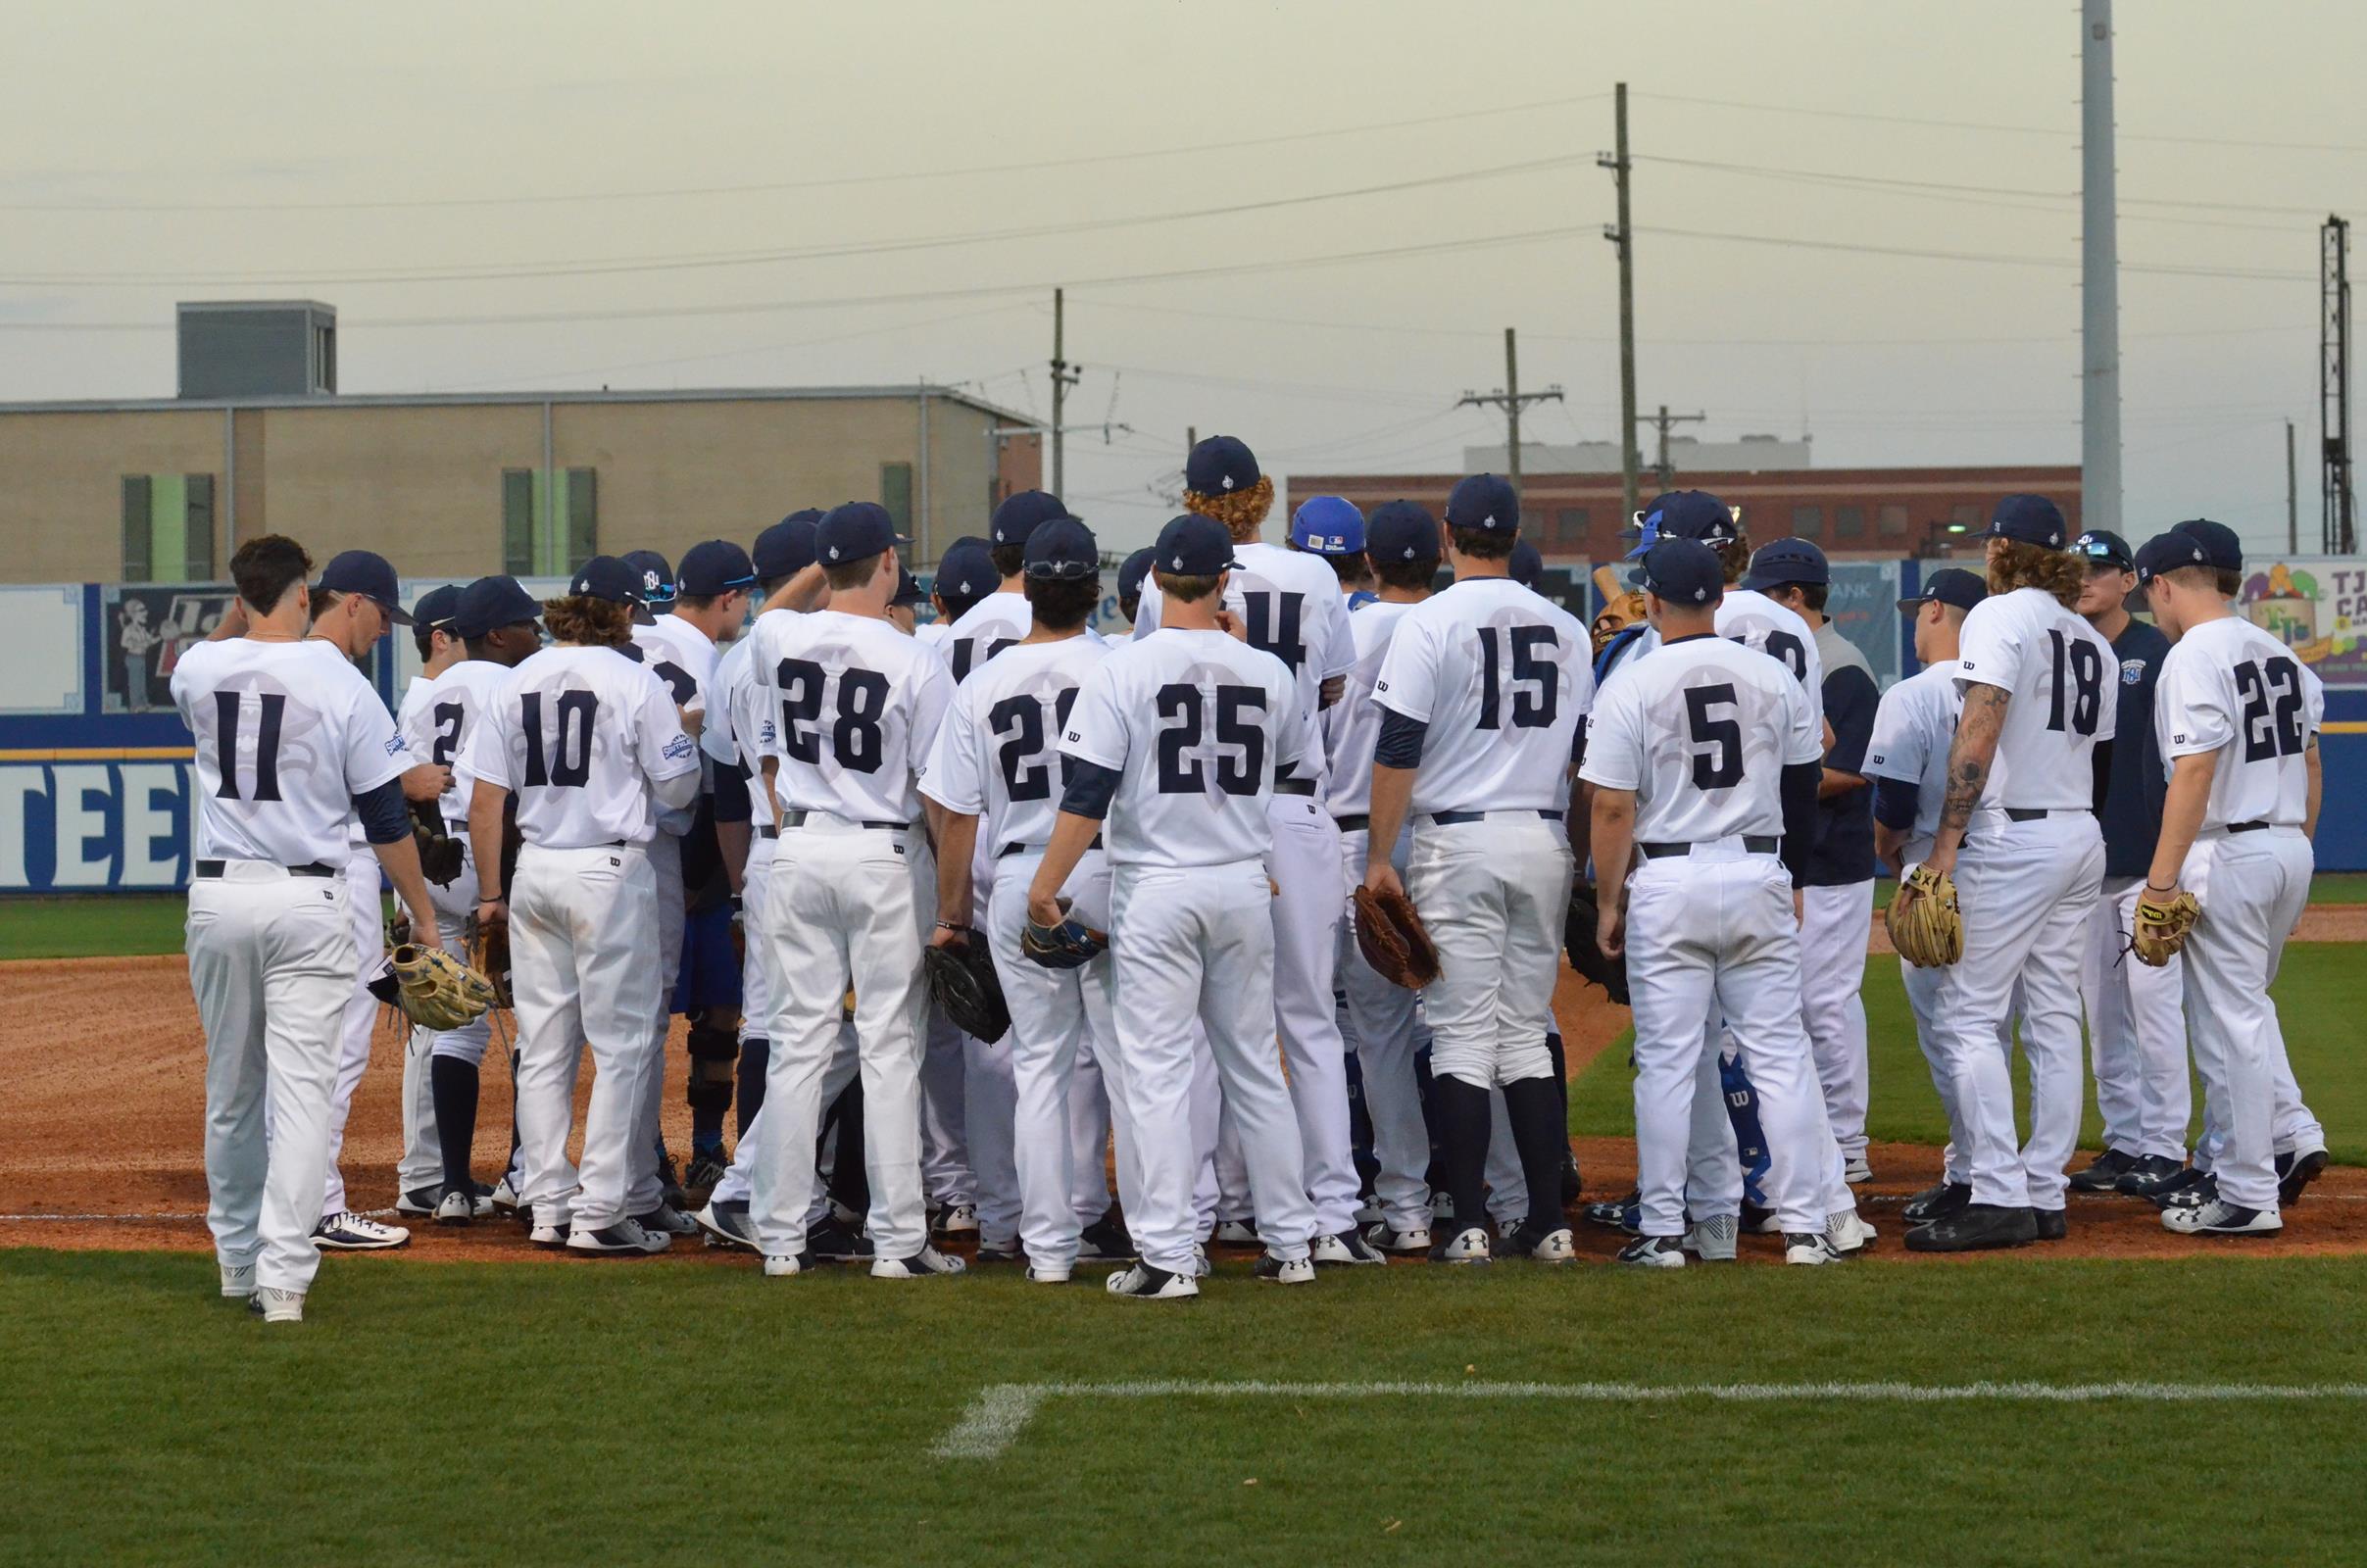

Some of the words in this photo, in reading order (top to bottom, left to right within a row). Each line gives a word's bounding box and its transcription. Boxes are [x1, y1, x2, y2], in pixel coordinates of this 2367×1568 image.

[776, 658, 891, 774] 28
[1475, 624, 1559, 730] 15
[2046, 628, 2102, 737] 18
[2233, 656, 2303, 763] 22
[214, 691, 285, 802] 11
[520, 689, 600, 788] 10
[1156, 683, 1267, 797] 25
[1683, 683, 1745, 791] 5
[0, 764, 196, 886] TEE
